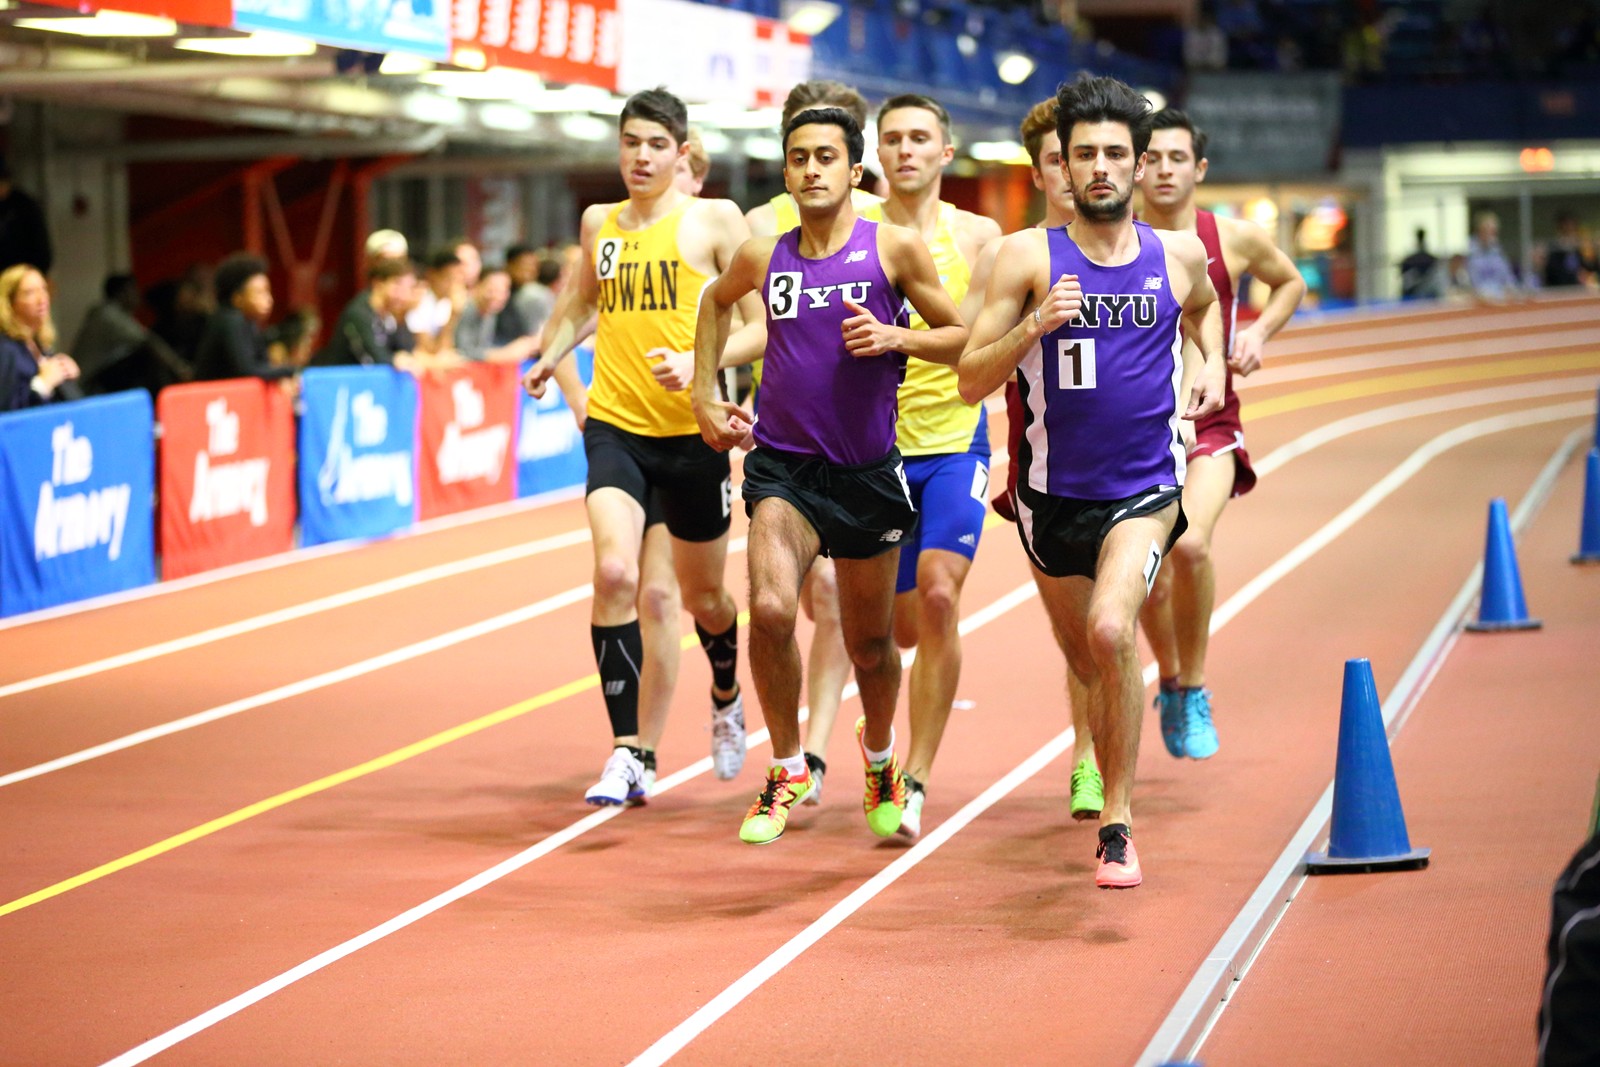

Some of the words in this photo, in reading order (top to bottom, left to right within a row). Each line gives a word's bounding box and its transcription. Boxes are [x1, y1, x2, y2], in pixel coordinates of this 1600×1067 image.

[599, 241, 616, 277] 8
[600, 260, 679, 313] OWAN
[772, 275, 794, 316] 3
[1069, 293, 1157, 328] NYU
[1063, 342, 1083, 386] 1
[52, 420, 93, 487] The
[34, 480, 131, 563] Armory
[1147, 549, 1161, 585] 1
